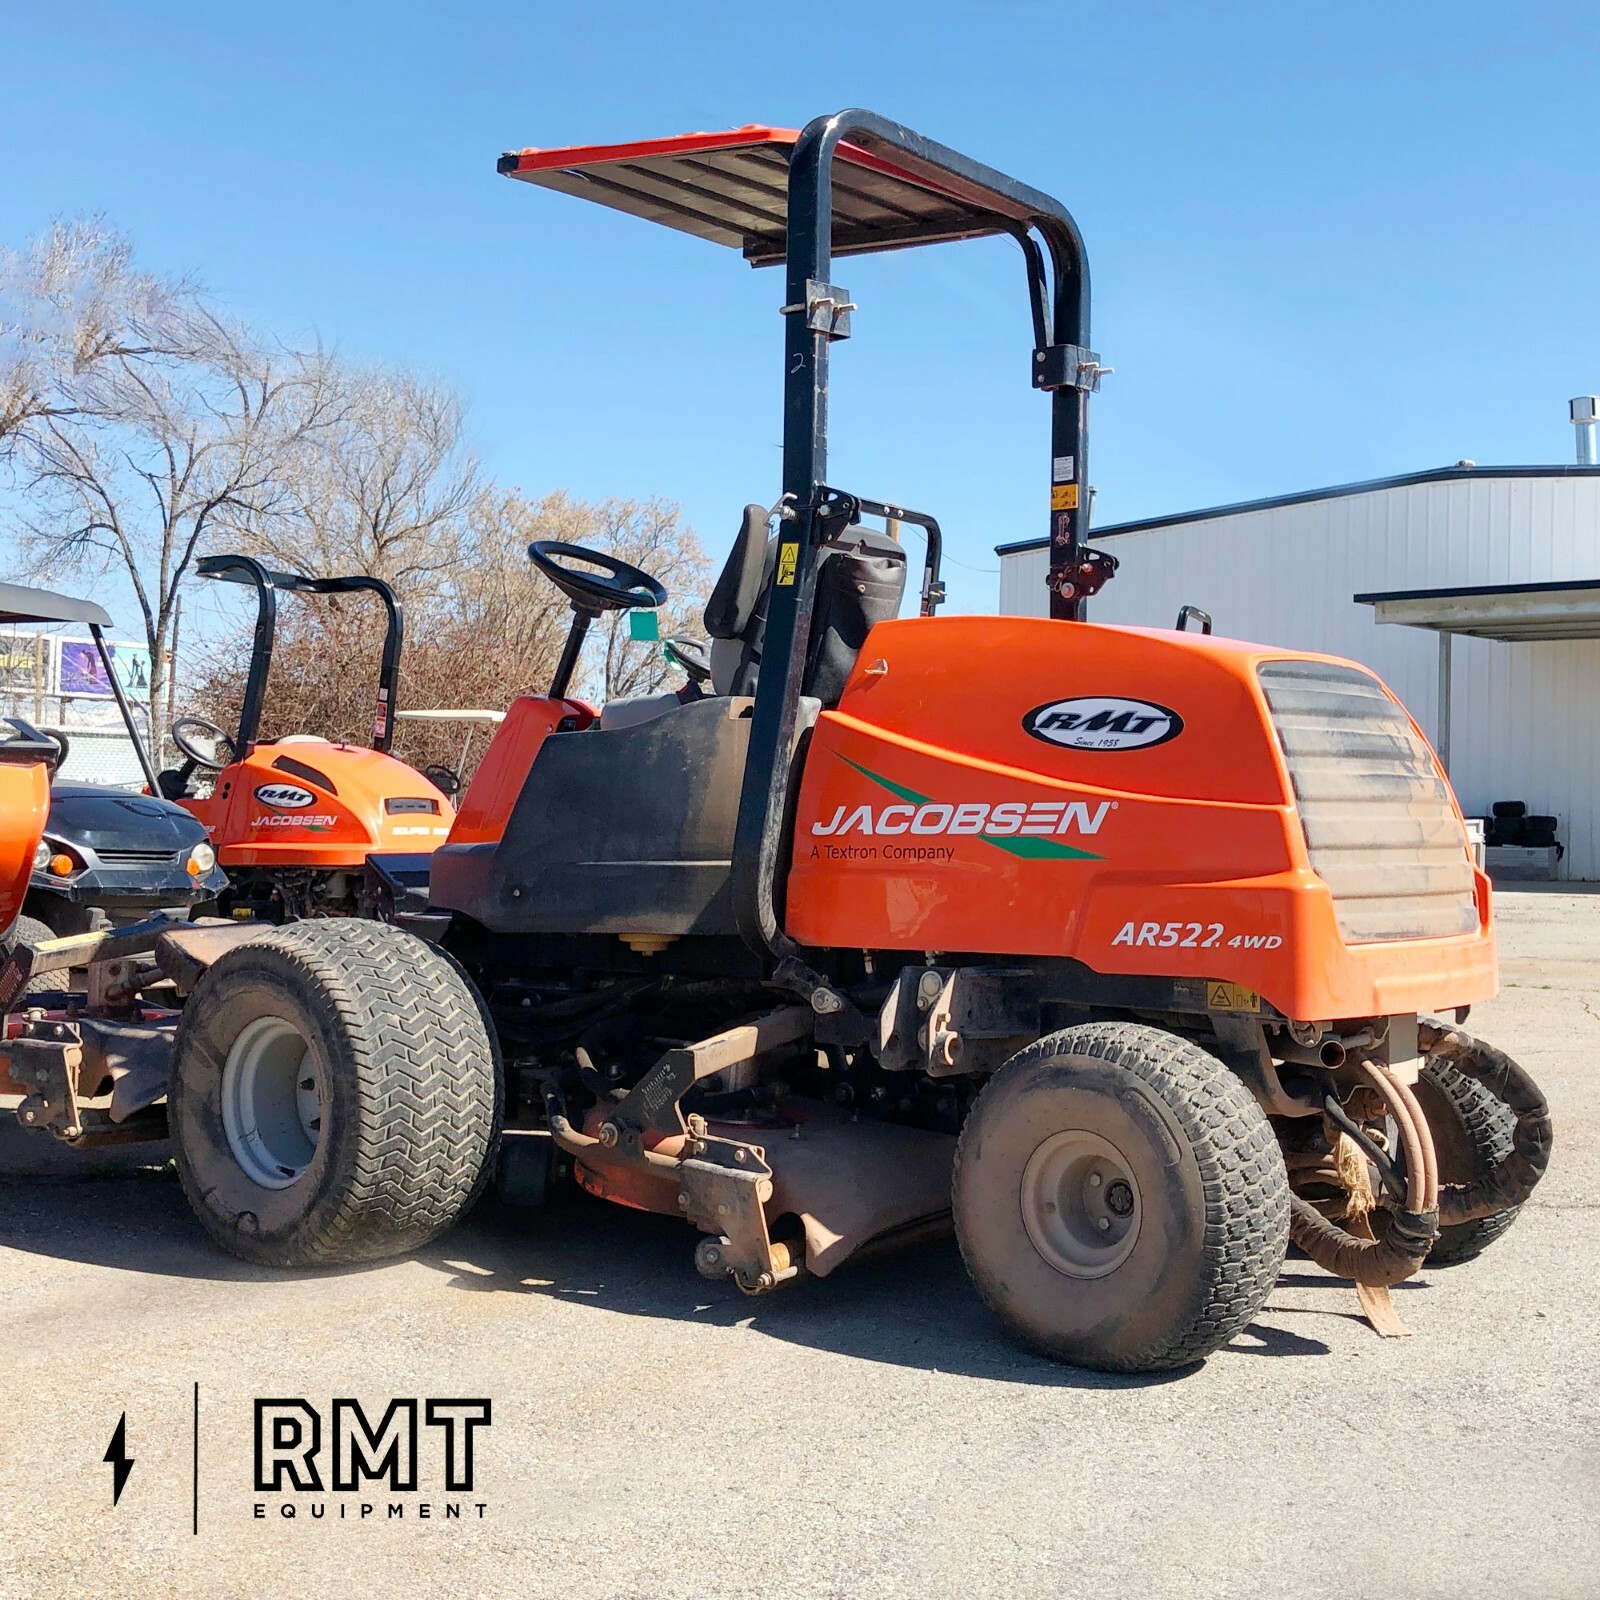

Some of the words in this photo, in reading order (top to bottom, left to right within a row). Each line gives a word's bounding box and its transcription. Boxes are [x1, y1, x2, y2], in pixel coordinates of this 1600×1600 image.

[1032, 709, 1172, 735] RMT
[1073, 737, 1095, 747] Since
[259, 789, 312, 802] RMT
[250, 815, 338, 826] JACOBSEN
[810, 845, 820, 860] A
[824, 844, 877, 860] Textron
[882, 844, 955, 863] Company
[1227, 935, 1283, 949] 4WD
